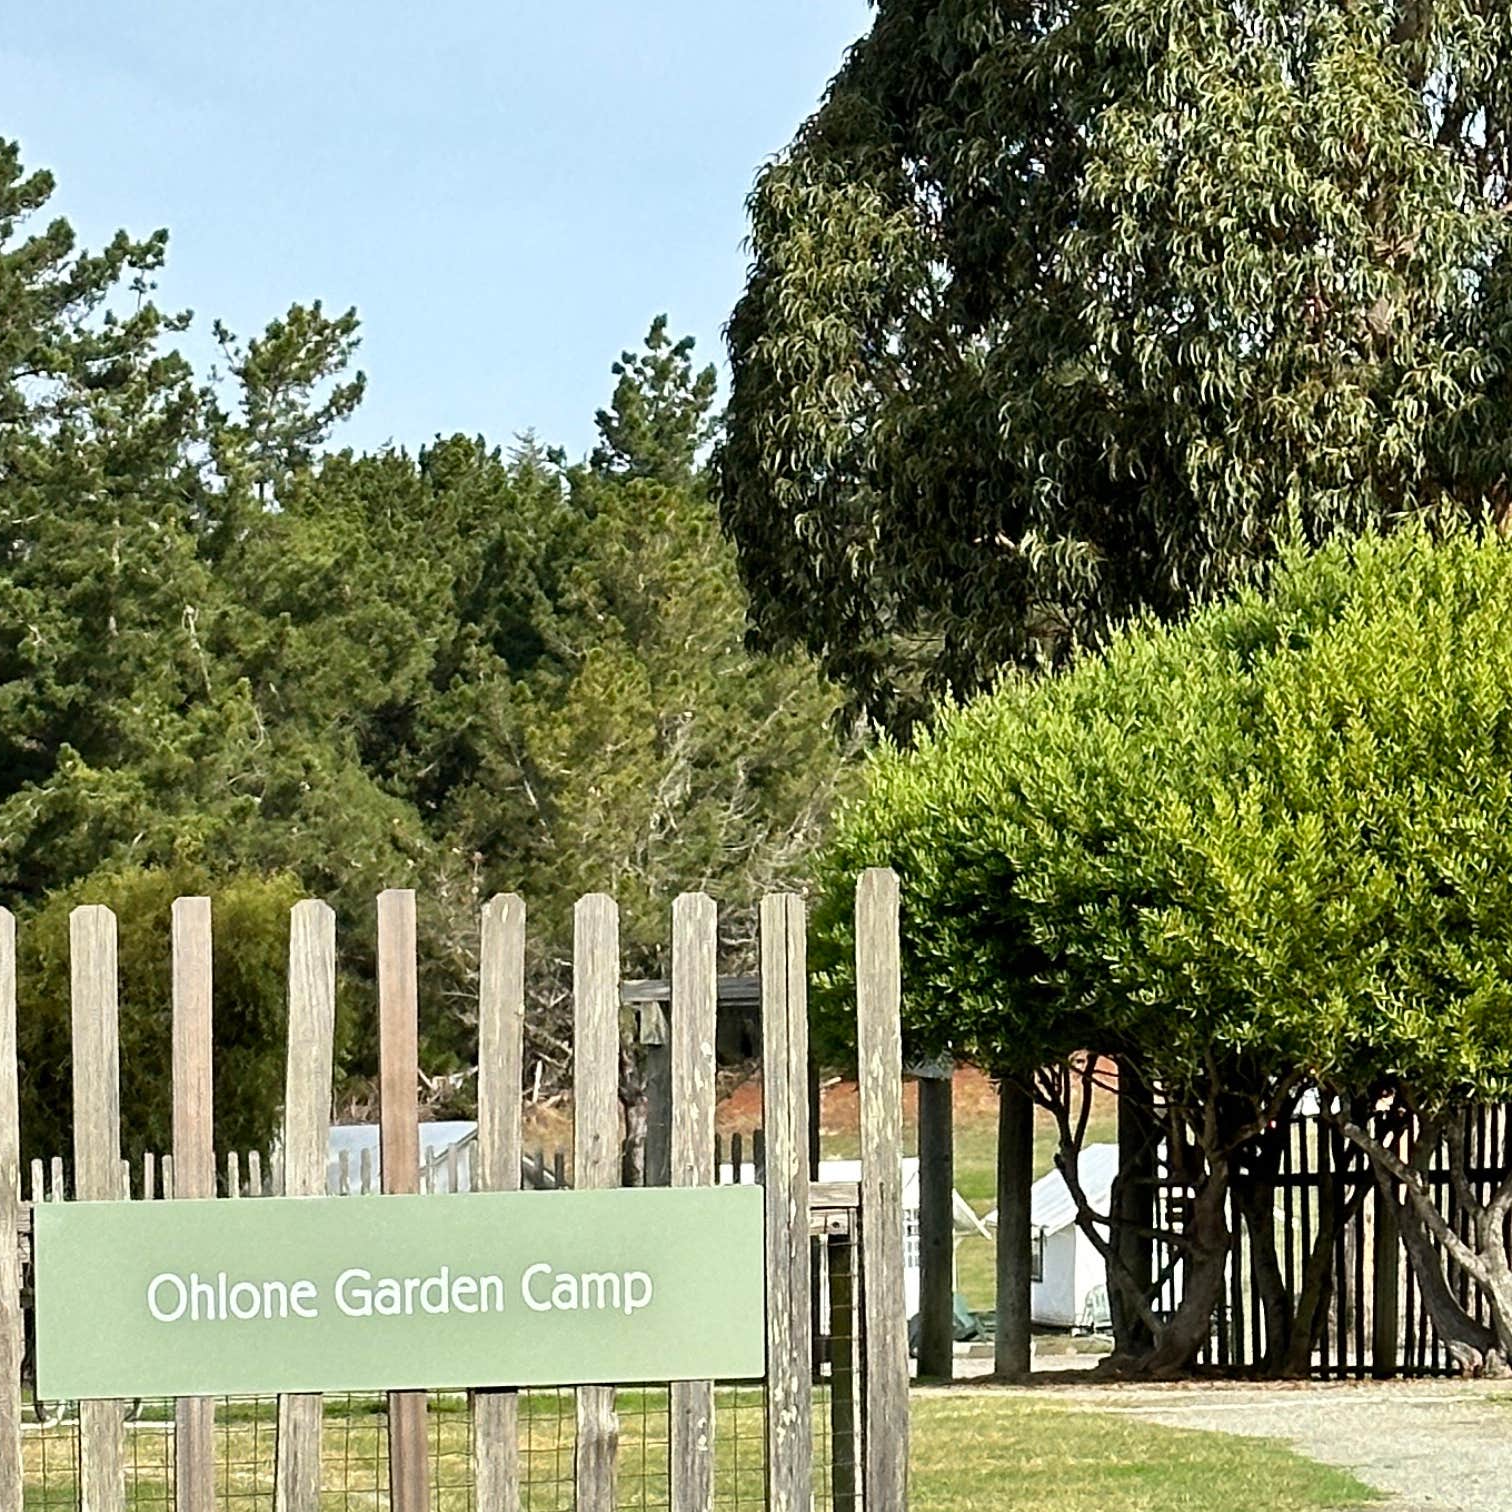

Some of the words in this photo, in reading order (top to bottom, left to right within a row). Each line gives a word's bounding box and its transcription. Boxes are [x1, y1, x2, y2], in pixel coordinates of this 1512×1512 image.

[147, 1271, 318, 1323] Ohlone
[334, 1266, 504, 1317] Garden
[521, 1263, 654, 1316] Camp
